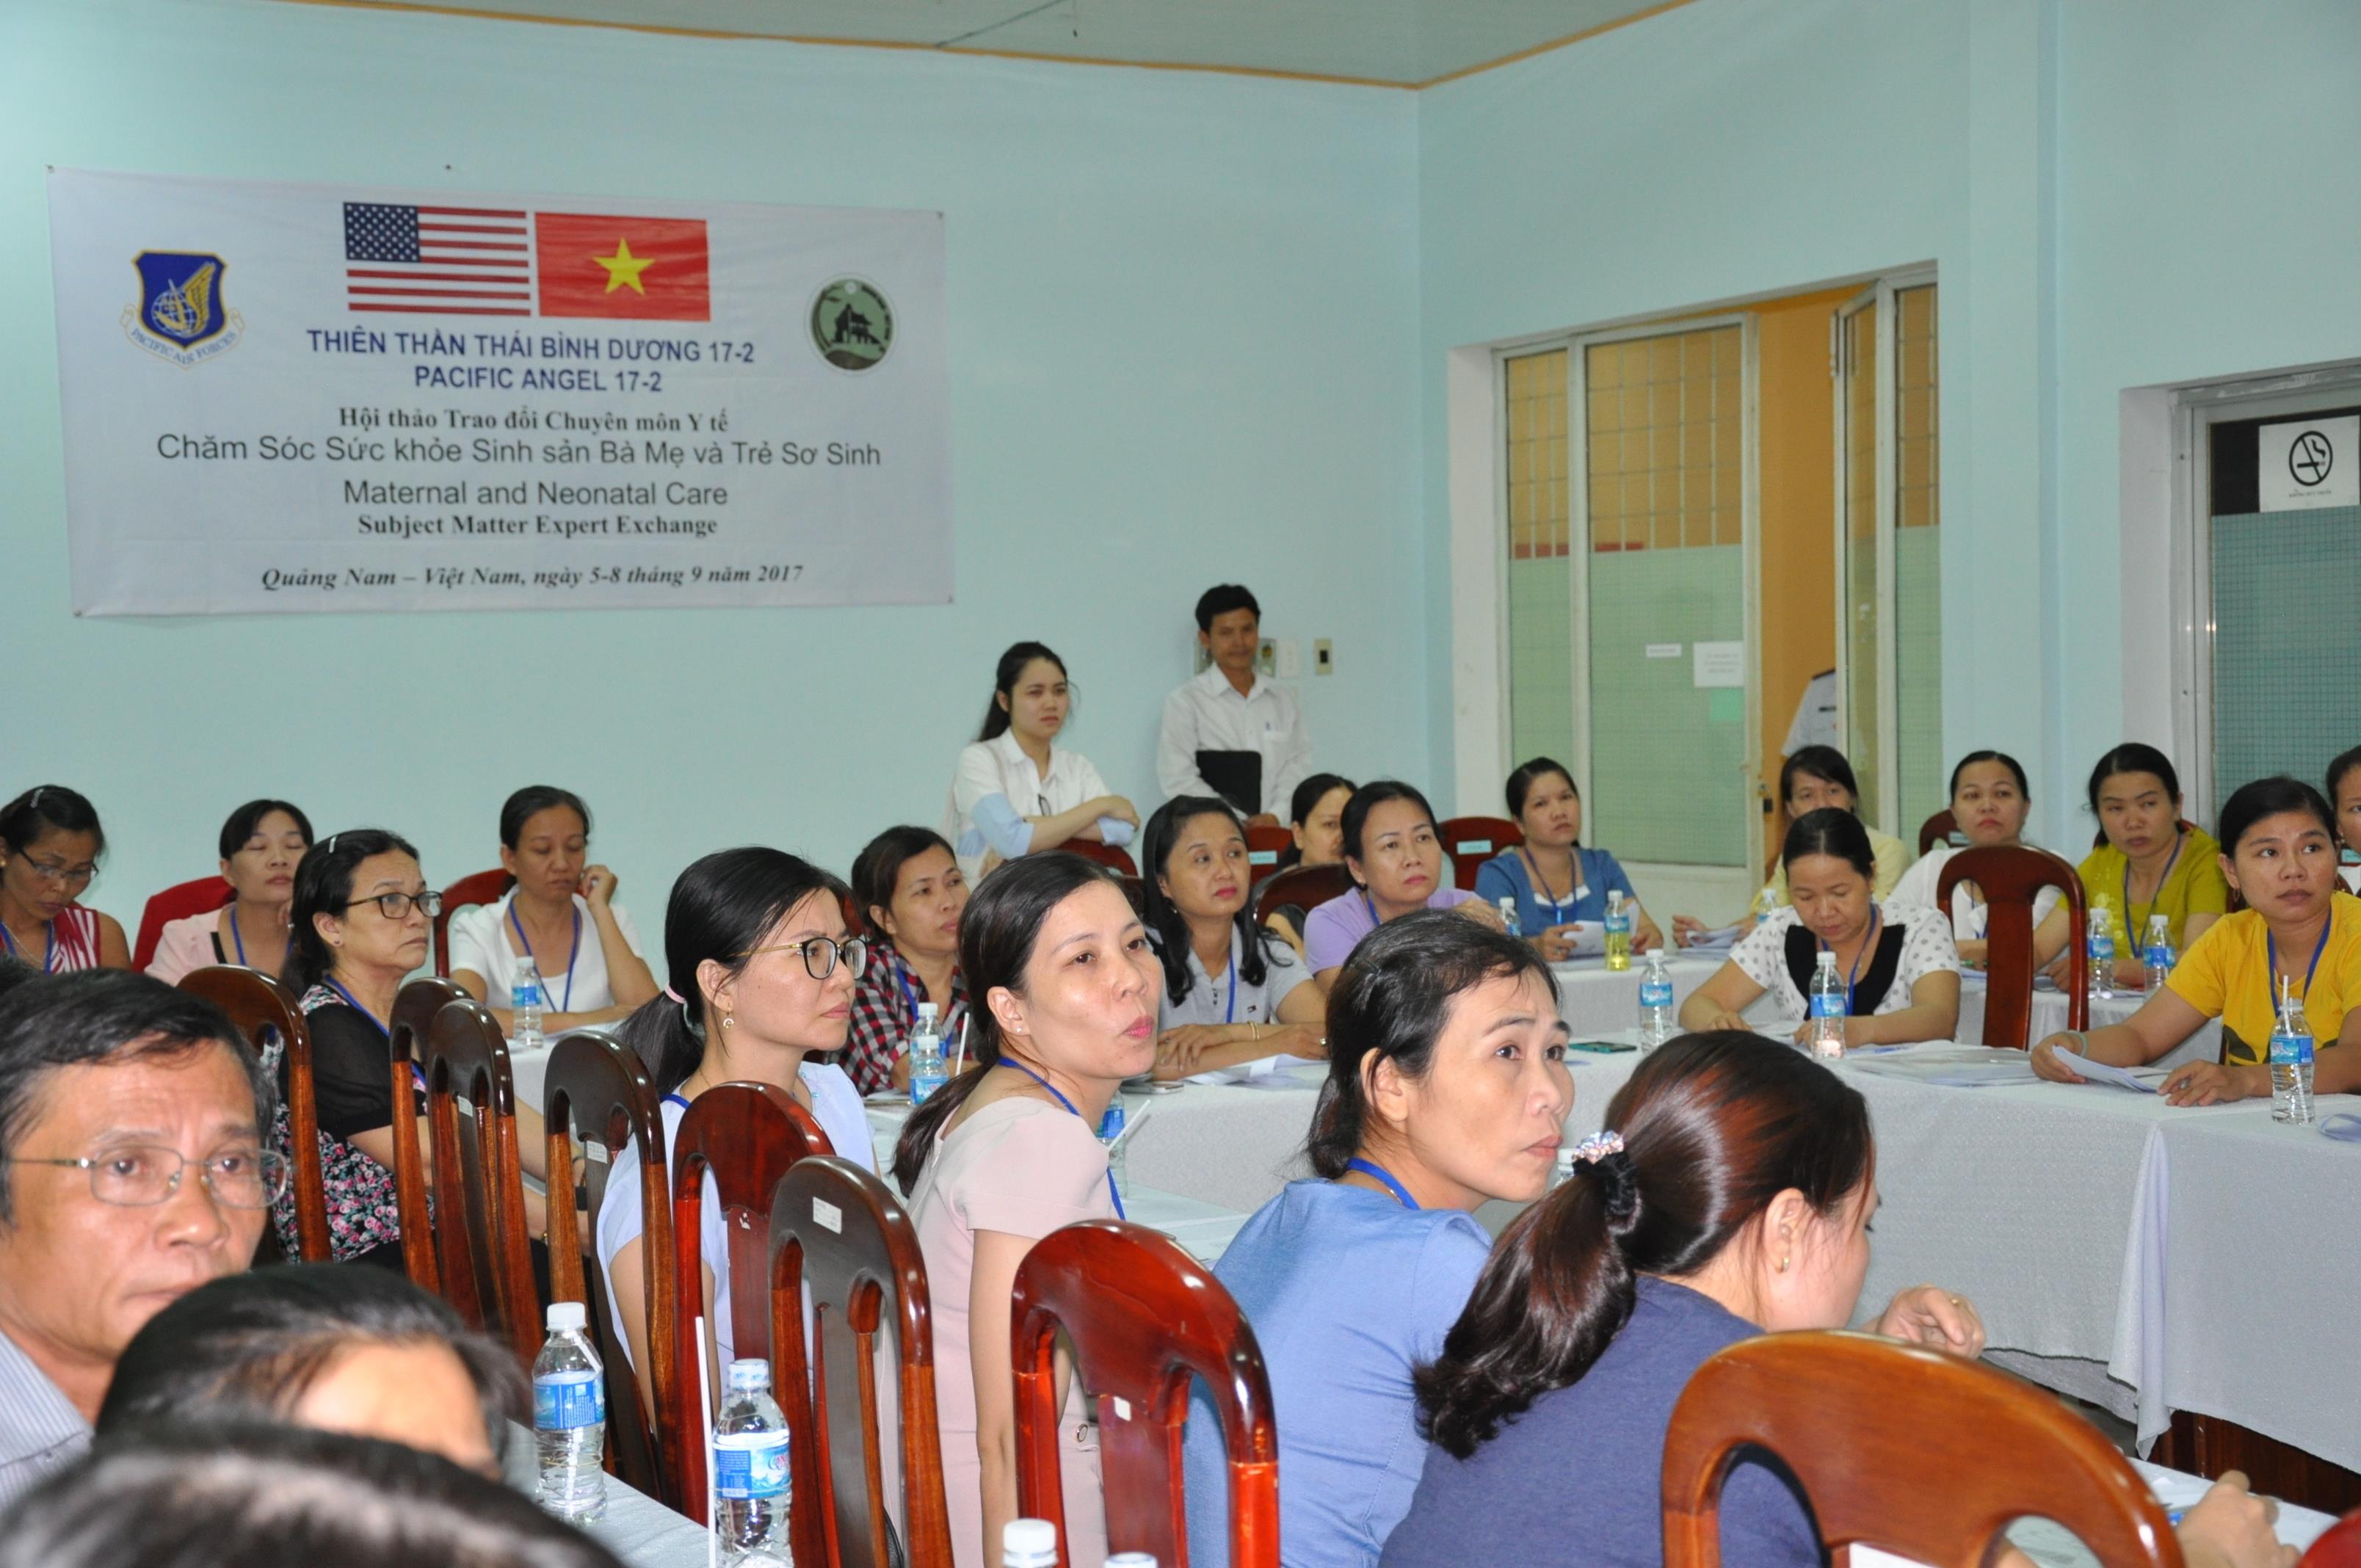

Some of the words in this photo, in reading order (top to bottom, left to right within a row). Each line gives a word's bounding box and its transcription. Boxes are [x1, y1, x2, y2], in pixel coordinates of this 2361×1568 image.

[131, 328, 174, 357] PACIFIC
[306, 325, 386, 354] THIÊN
[474, 330, 532, 357] THÁI
[541, 331, 599, 360] BÌNH
[608, 338, 700, 362] DƯƠNG
[709, 341, 754, 363] 17-2
[415, 365, 513, 389] PACIFIC
[521, 369, 607, 391] ANGEL
[615, 371, 662, 392] 17-2
[339, 407, 380, 432] Hội
[388, 408, 438, 428] thảo
[444, 410, 497, 429] Trao
[545, 411, 628, 436] Chuyên
[636, 413, 681, 431] môn
[688, 413, 702, 432] Y
[710, 408, 728, 432] tế
[157, 434, 247, 460] Chăm
[259, 435, 316, 461] Sóc
[326, 436, 385, 462] Sức
[394, 437, 462, 462] khỏe
[472, 438, 532, 462] Sinh
[543, 438, 590, 463] sản
[601, 440, 635, 463] Bà
[645, 440, 684, 468] Mẹ
[693, 441, 723, 464] và
[731, 440, 772, 465] Trẻ
[782, 442, 818, 465] Sơ
[827, 443, 880, 465] Sinh
[344, 479, 466, 504] Maternal
[477, 481, 526, 504] and
[538, 482, 656, 505] Neonatal
[666, 482, 728, 505] Care
[358, 515, 443, 539] Subject
[452, 515, 529, 534] Matter
[536, 515, 608, 539] Expert
[617, 515, 717, 538] Exchange
[345, 568, 396, 586] Nam
[426, 567, 465, 589] Việt
[471, 567, 526, 586] Nam,
[533, 567, 583, 589] ngày
[590, 567, 621, 584] 5-8
[627, 567, 683, 587] tháng
[692, 567, 703, 581] 9
[708, 567, 750, 582] năm
[758, 565, 803, 581] 2017
